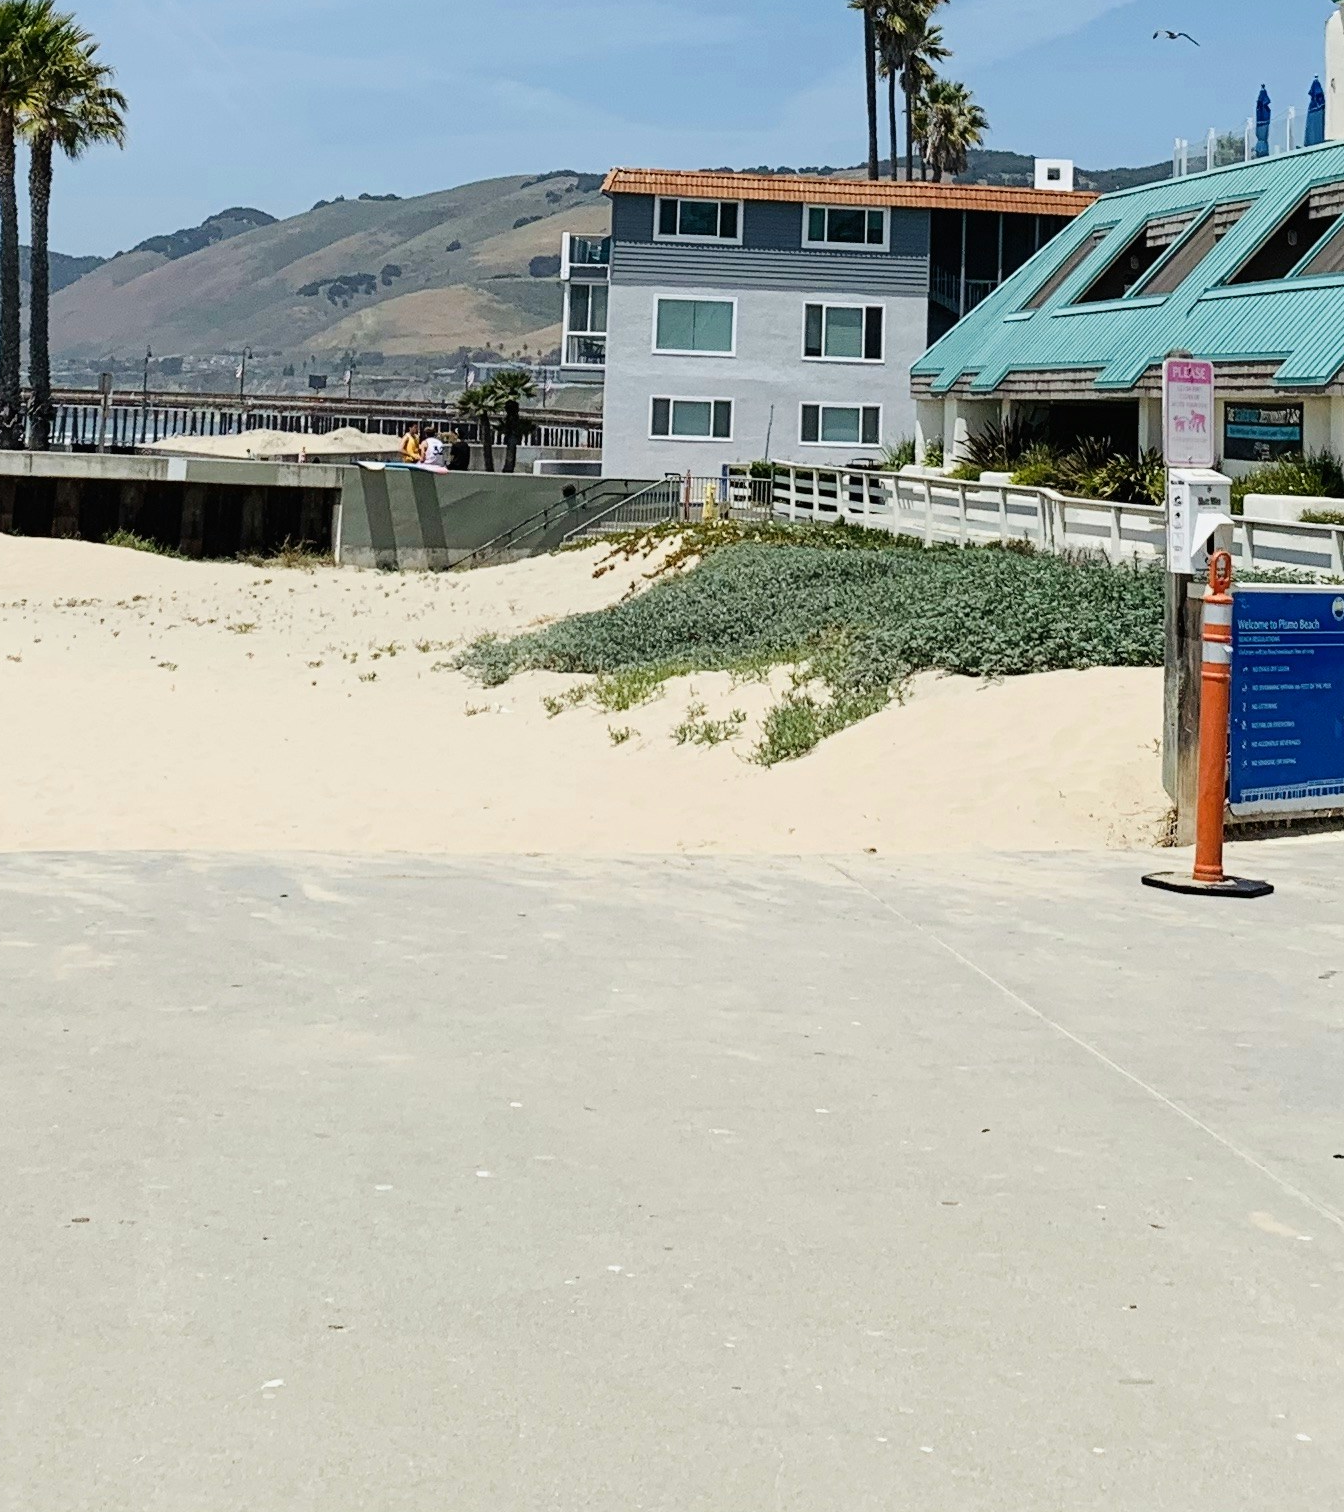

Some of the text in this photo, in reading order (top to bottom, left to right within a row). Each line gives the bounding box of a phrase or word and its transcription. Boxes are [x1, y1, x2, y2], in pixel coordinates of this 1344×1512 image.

[1173, 367, 1206, 380] PLEASE
[1238, 619, 1320, 629] Welcome to Pismo Beach
